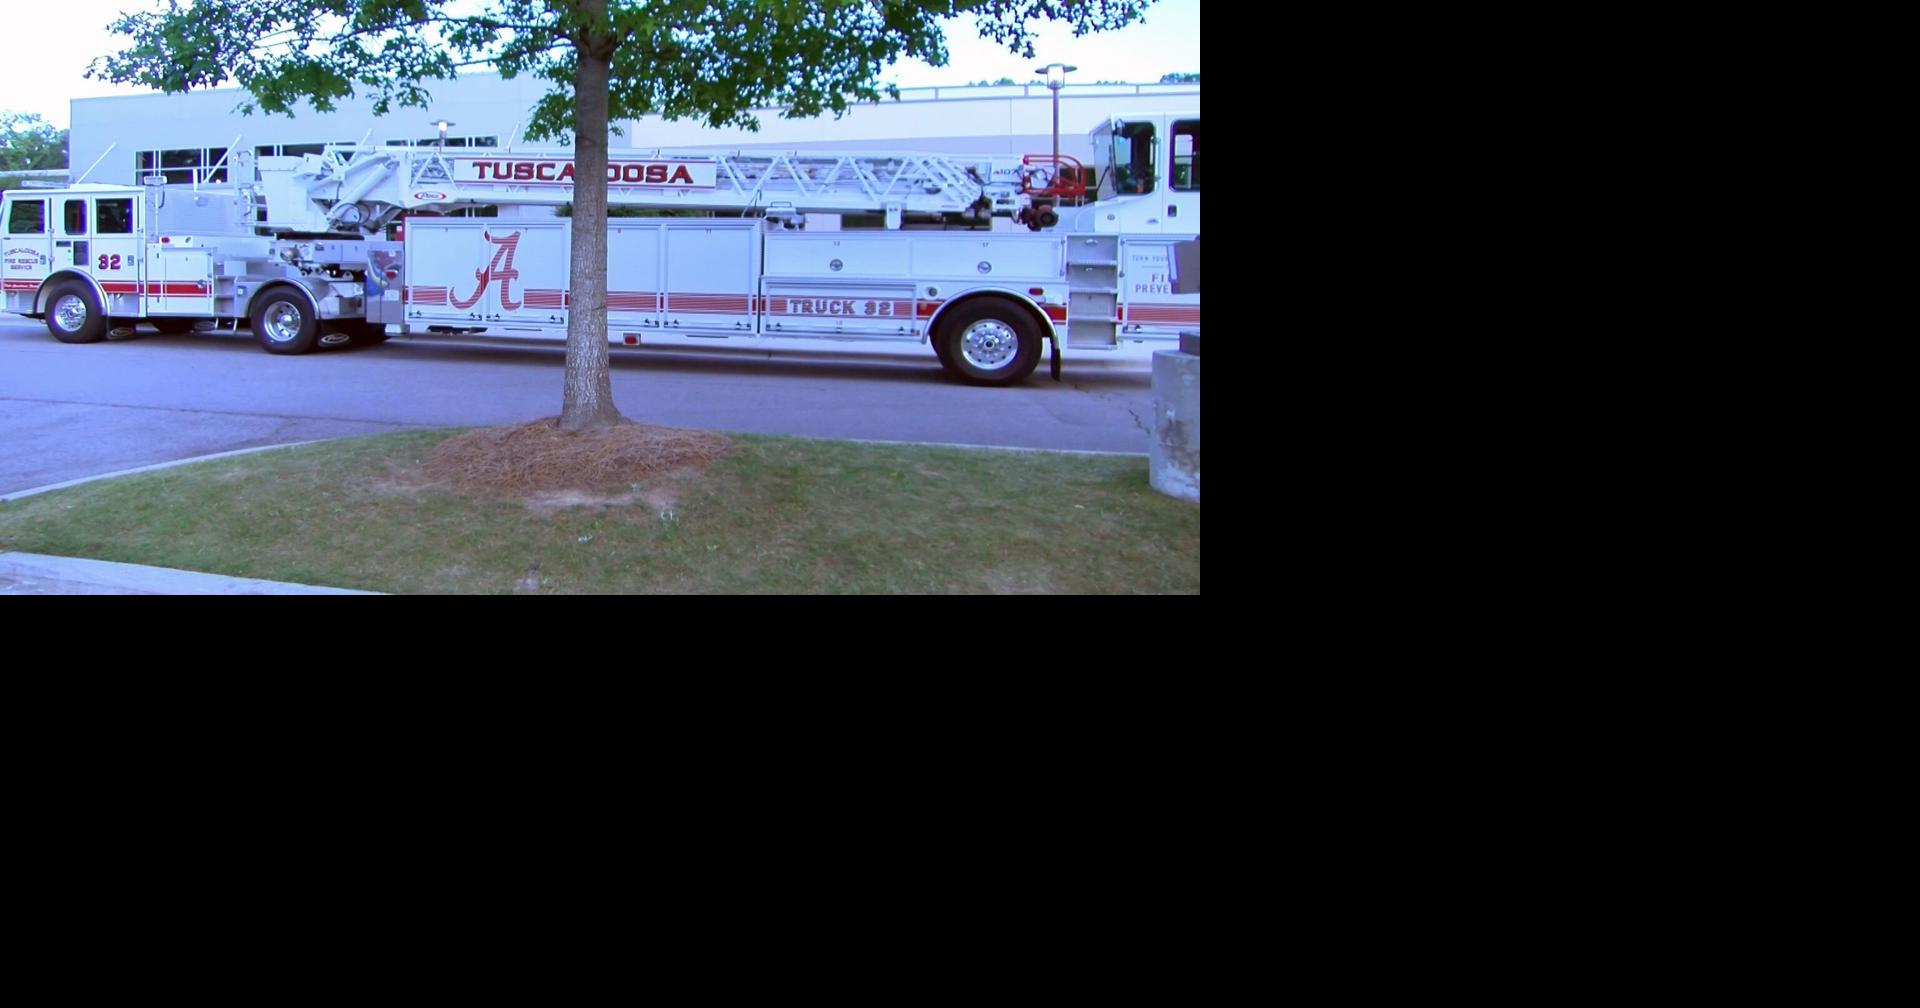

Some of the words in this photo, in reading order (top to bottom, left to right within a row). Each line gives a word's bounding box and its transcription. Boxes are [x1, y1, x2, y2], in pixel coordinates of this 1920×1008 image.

[472, 161, 694, 184] TUSCAOOSA
[98, 254, 121, 270] 32
[1135, 284, 1169, 294] PREVE
[789, 299, 855, 315] TRUCK
[864, 300, 891, 316] 32
